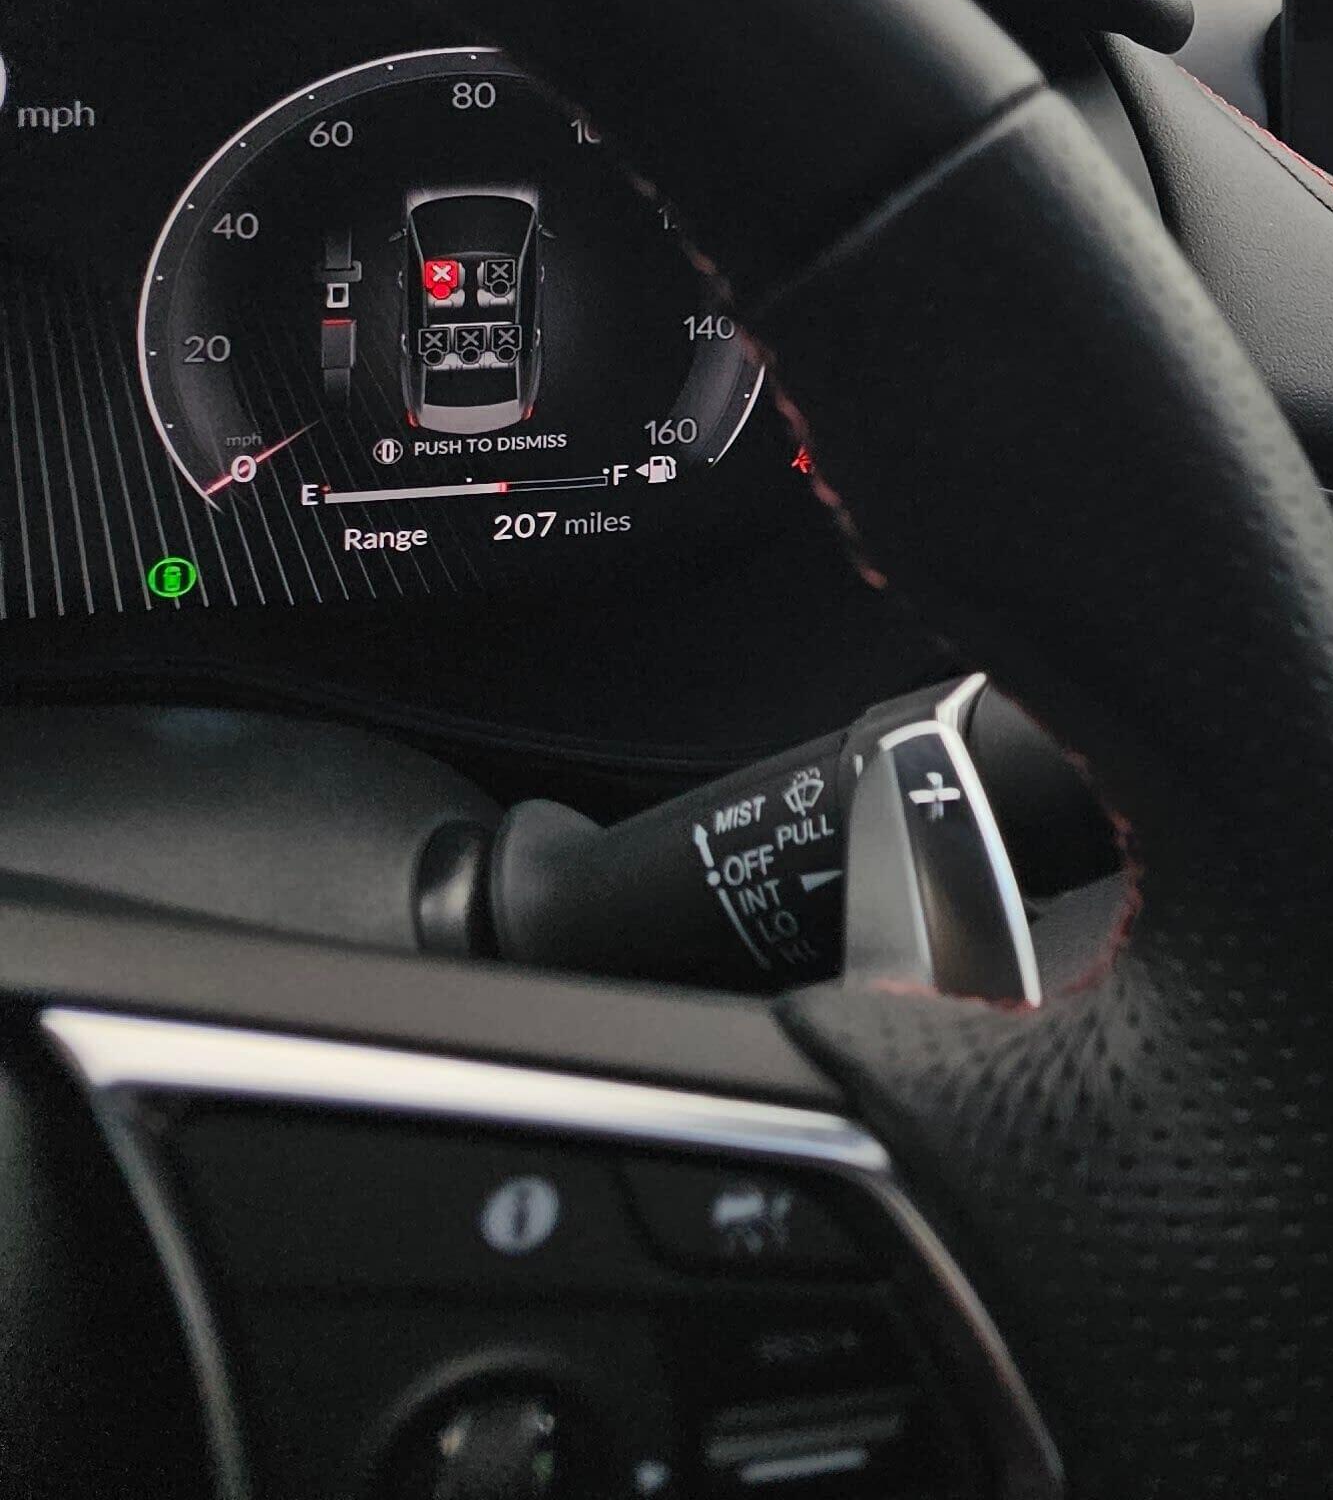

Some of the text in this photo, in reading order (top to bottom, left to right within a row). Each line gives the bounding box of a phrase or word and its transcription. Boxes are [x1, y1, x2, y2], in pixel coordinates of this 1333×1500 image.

[452, 82, 496, 109] 80
[18, 100, 95, 134] mph
[309, 121, 354, 147] 60
[212, 213, 259, 240] 40
[683, 315, 735, 341] 140
[183, 335, 231, 363] 20
[226, 432, 262, 447] mph
[414, 433, 567, 457] PUSH TO DISMISS
[644, 418, 697, 445] 160
[231, 455, 257, 484] 0
[613, 464, 629, 486] F
[301, 484, 319, 506] E
[344, 527, 428, 552] Range
[493, 511, 632, 541] 207 miles
[715, 795, 766, 835] MIST
[776, 814, 835, 851] PULL
[723, 844, 775, 886] OFF
[738, 879, 782, 915] INT
